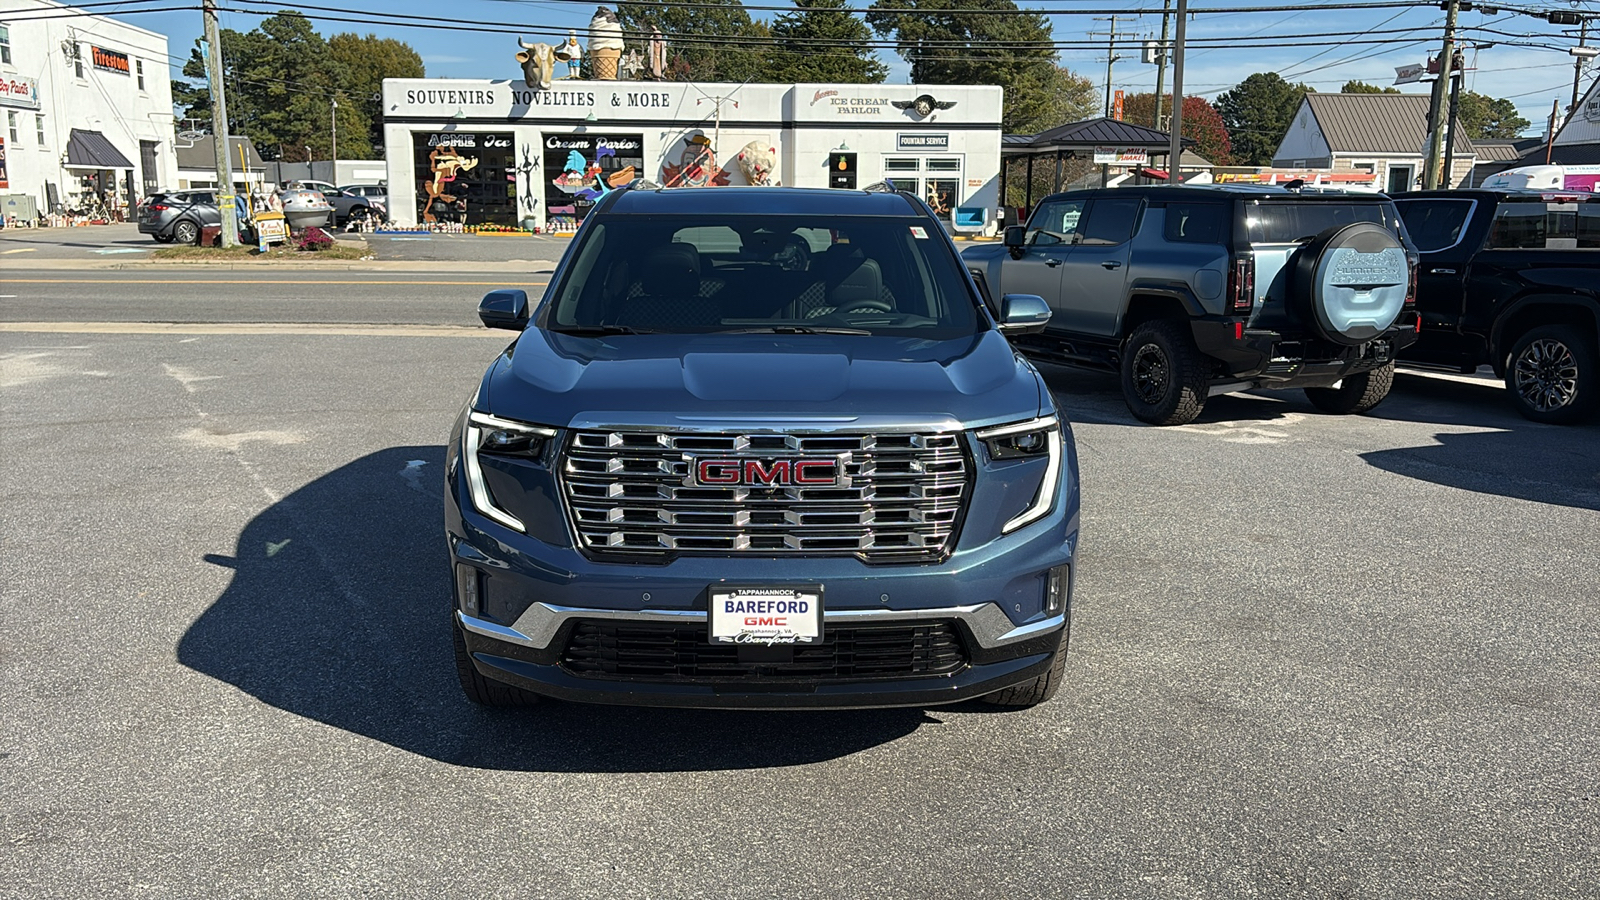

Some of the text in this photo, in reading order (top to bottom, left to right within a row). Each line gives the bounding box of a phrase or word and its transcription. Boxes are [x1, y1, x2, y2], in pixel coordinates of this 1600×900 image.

[92, 46, 129, 71] Firestone
[10, 80, 28, 95] Paints
[407, 89, 670, 107] SOUVENIRS NOVELTIES & MORE
[428, 134, 640, 149] ACME Ice Cream Parlor
[1337, 267, 1388, 275] HUMMER
[699, 459, 837, 484] GMC
[725, 601, 809, 613] BAREFORD
[744, 617, 787, 626] GMC
[735, 633, 799, 647] Bareford
